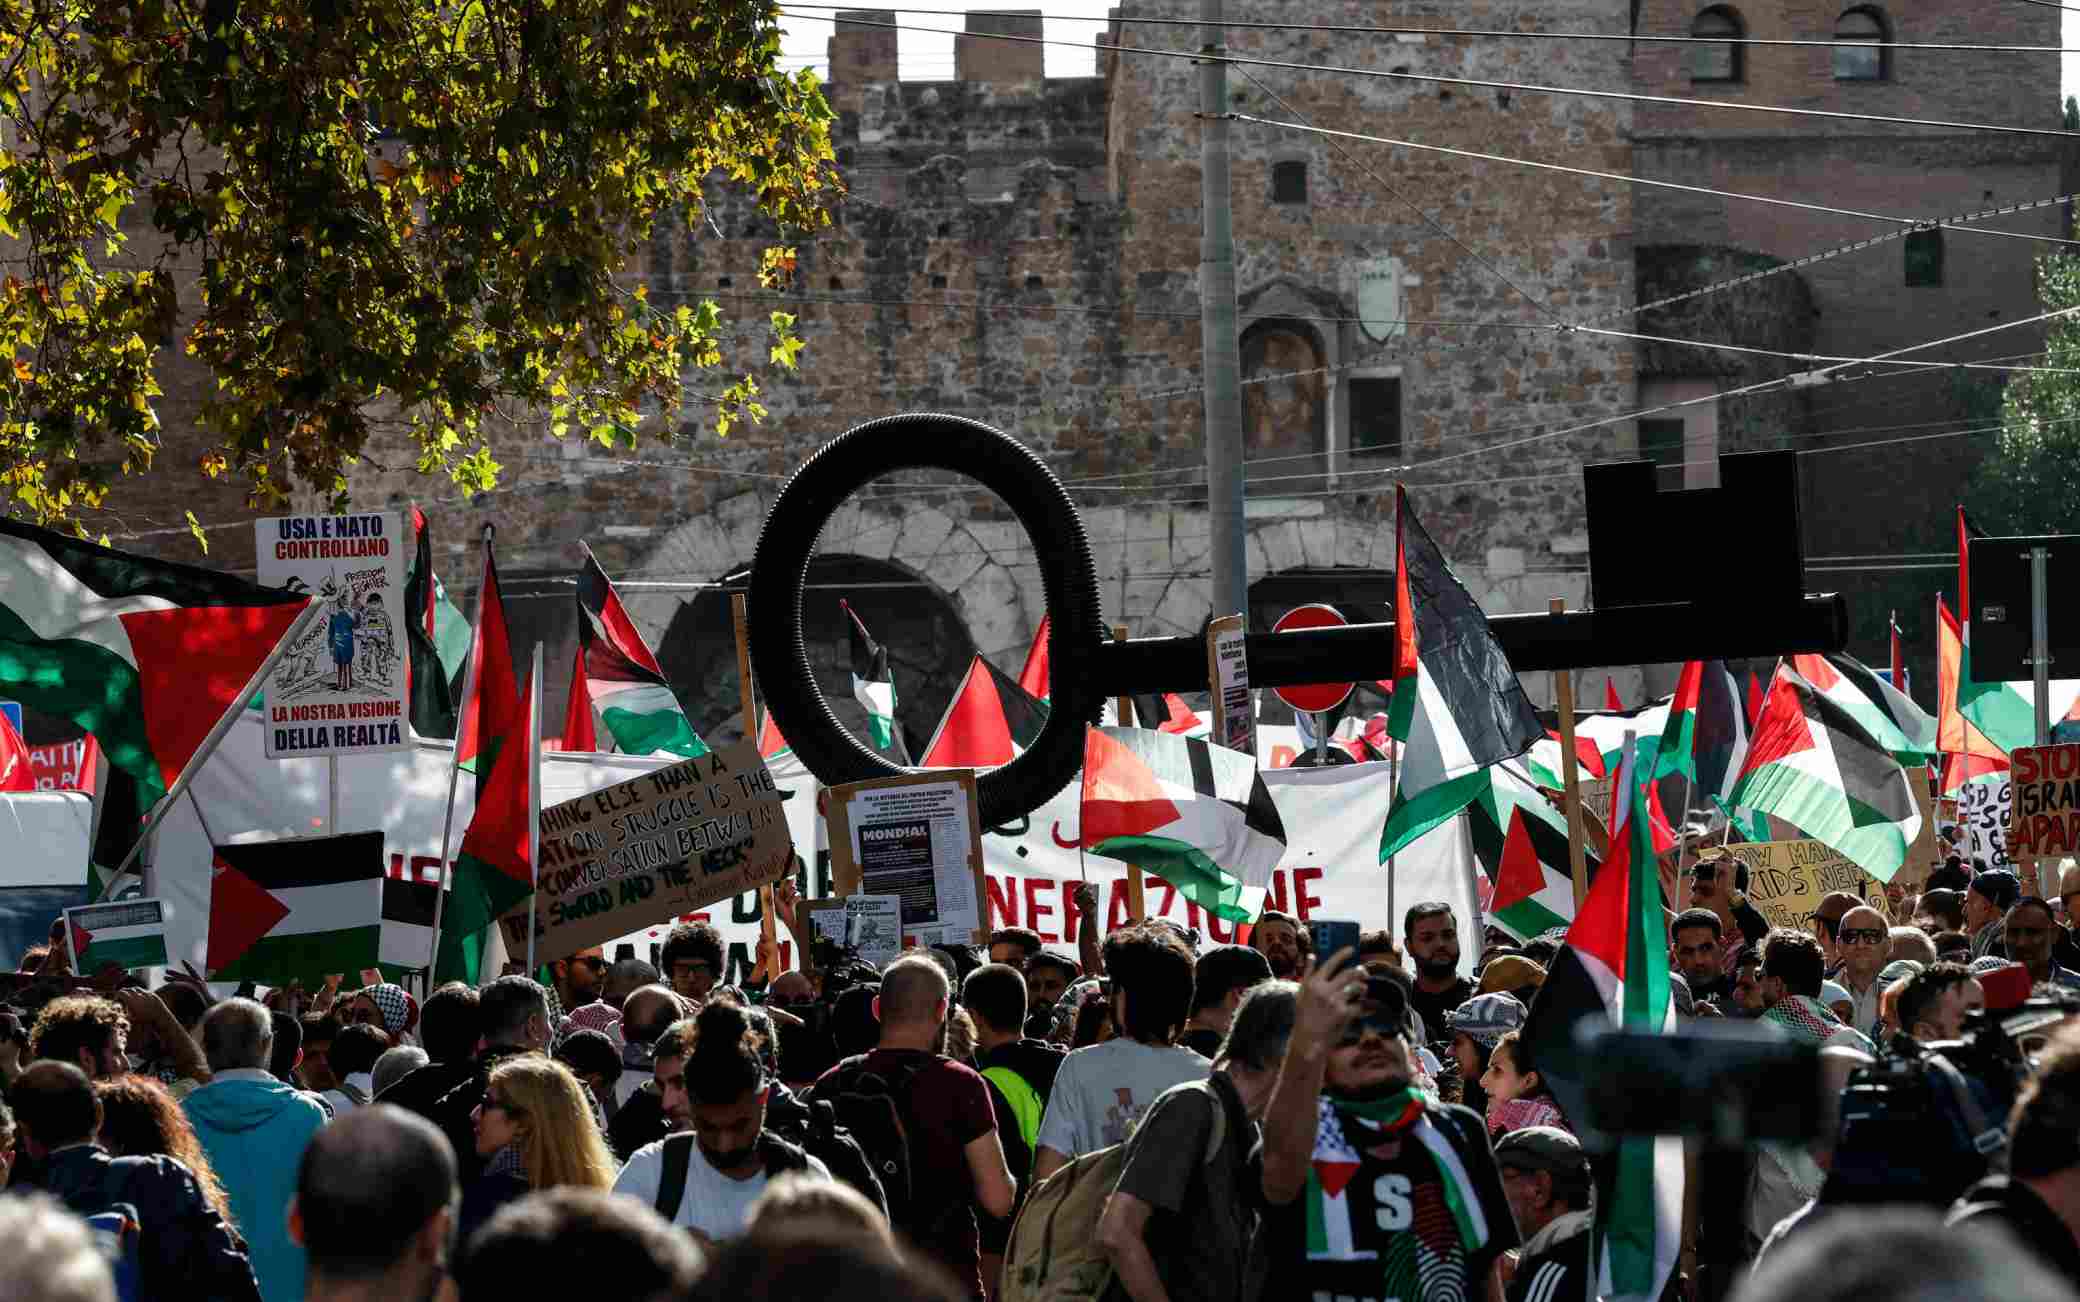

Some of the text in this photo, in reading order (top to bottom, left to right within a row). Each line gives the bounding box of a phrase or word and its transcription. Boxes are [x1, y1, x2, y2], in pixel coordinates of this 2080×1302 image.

[280, 516, 383, 539] USA E NATO
[276, 538, 390, 560] CONTROLLANO
[272, 700, 402, 722] LA NOSTRA VISIONE
[275, 727, 330, 751] DELLA
[2014, 747, 2080, 783] STO
[540, 753, 728, 833] THING ELSE THAN A
[541, 768, 777, 867] ATION STRUGGLE IS THE
[2015, 812, 2080, 856] APAR
[1736, 841, 1843, 867] OW MAN
[1750, 864, 1809, 900] KIDS
[549, 887, 613, 926] SWORD
